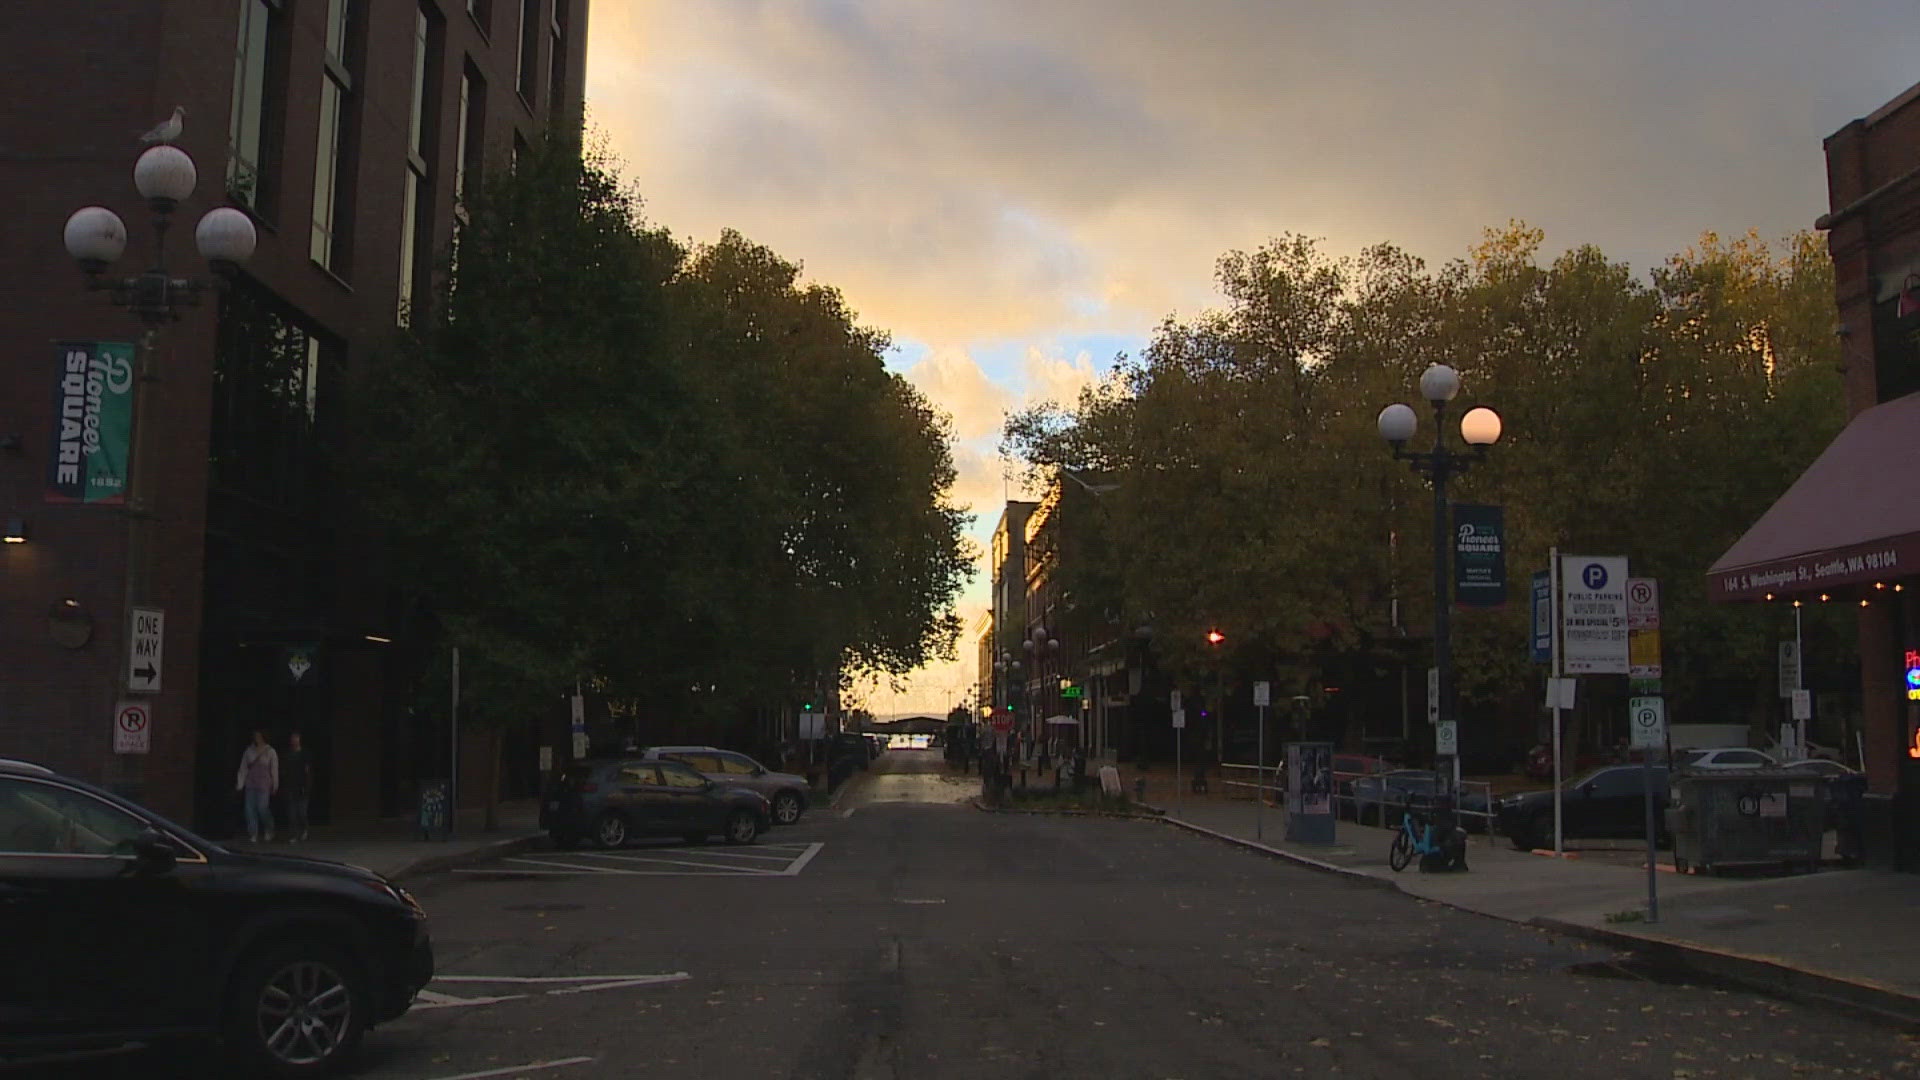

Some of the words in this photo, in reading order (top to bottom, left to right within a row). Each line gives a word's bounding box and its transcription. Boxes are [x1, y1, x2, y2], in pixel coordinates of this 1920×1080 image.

[82, 352, 133, 455] Pioneer
[57, 351, 88, 485] SQUARE
[1458, 523, 1499, 545] Pioneer
[1457, 544, 1501, 553] SQUARE
[1723, 576, 1739, 592] 164
[1749, 570, 1797, 588] Washington
[1865, 549, 1897, 571] 98104
[1567, 593, 1593, 601] PUBLIC
[1594, 593, 1623, 601] PARKING
[136, 616, 159, 635] ONE
[135, 639, 159, 657] WAY
